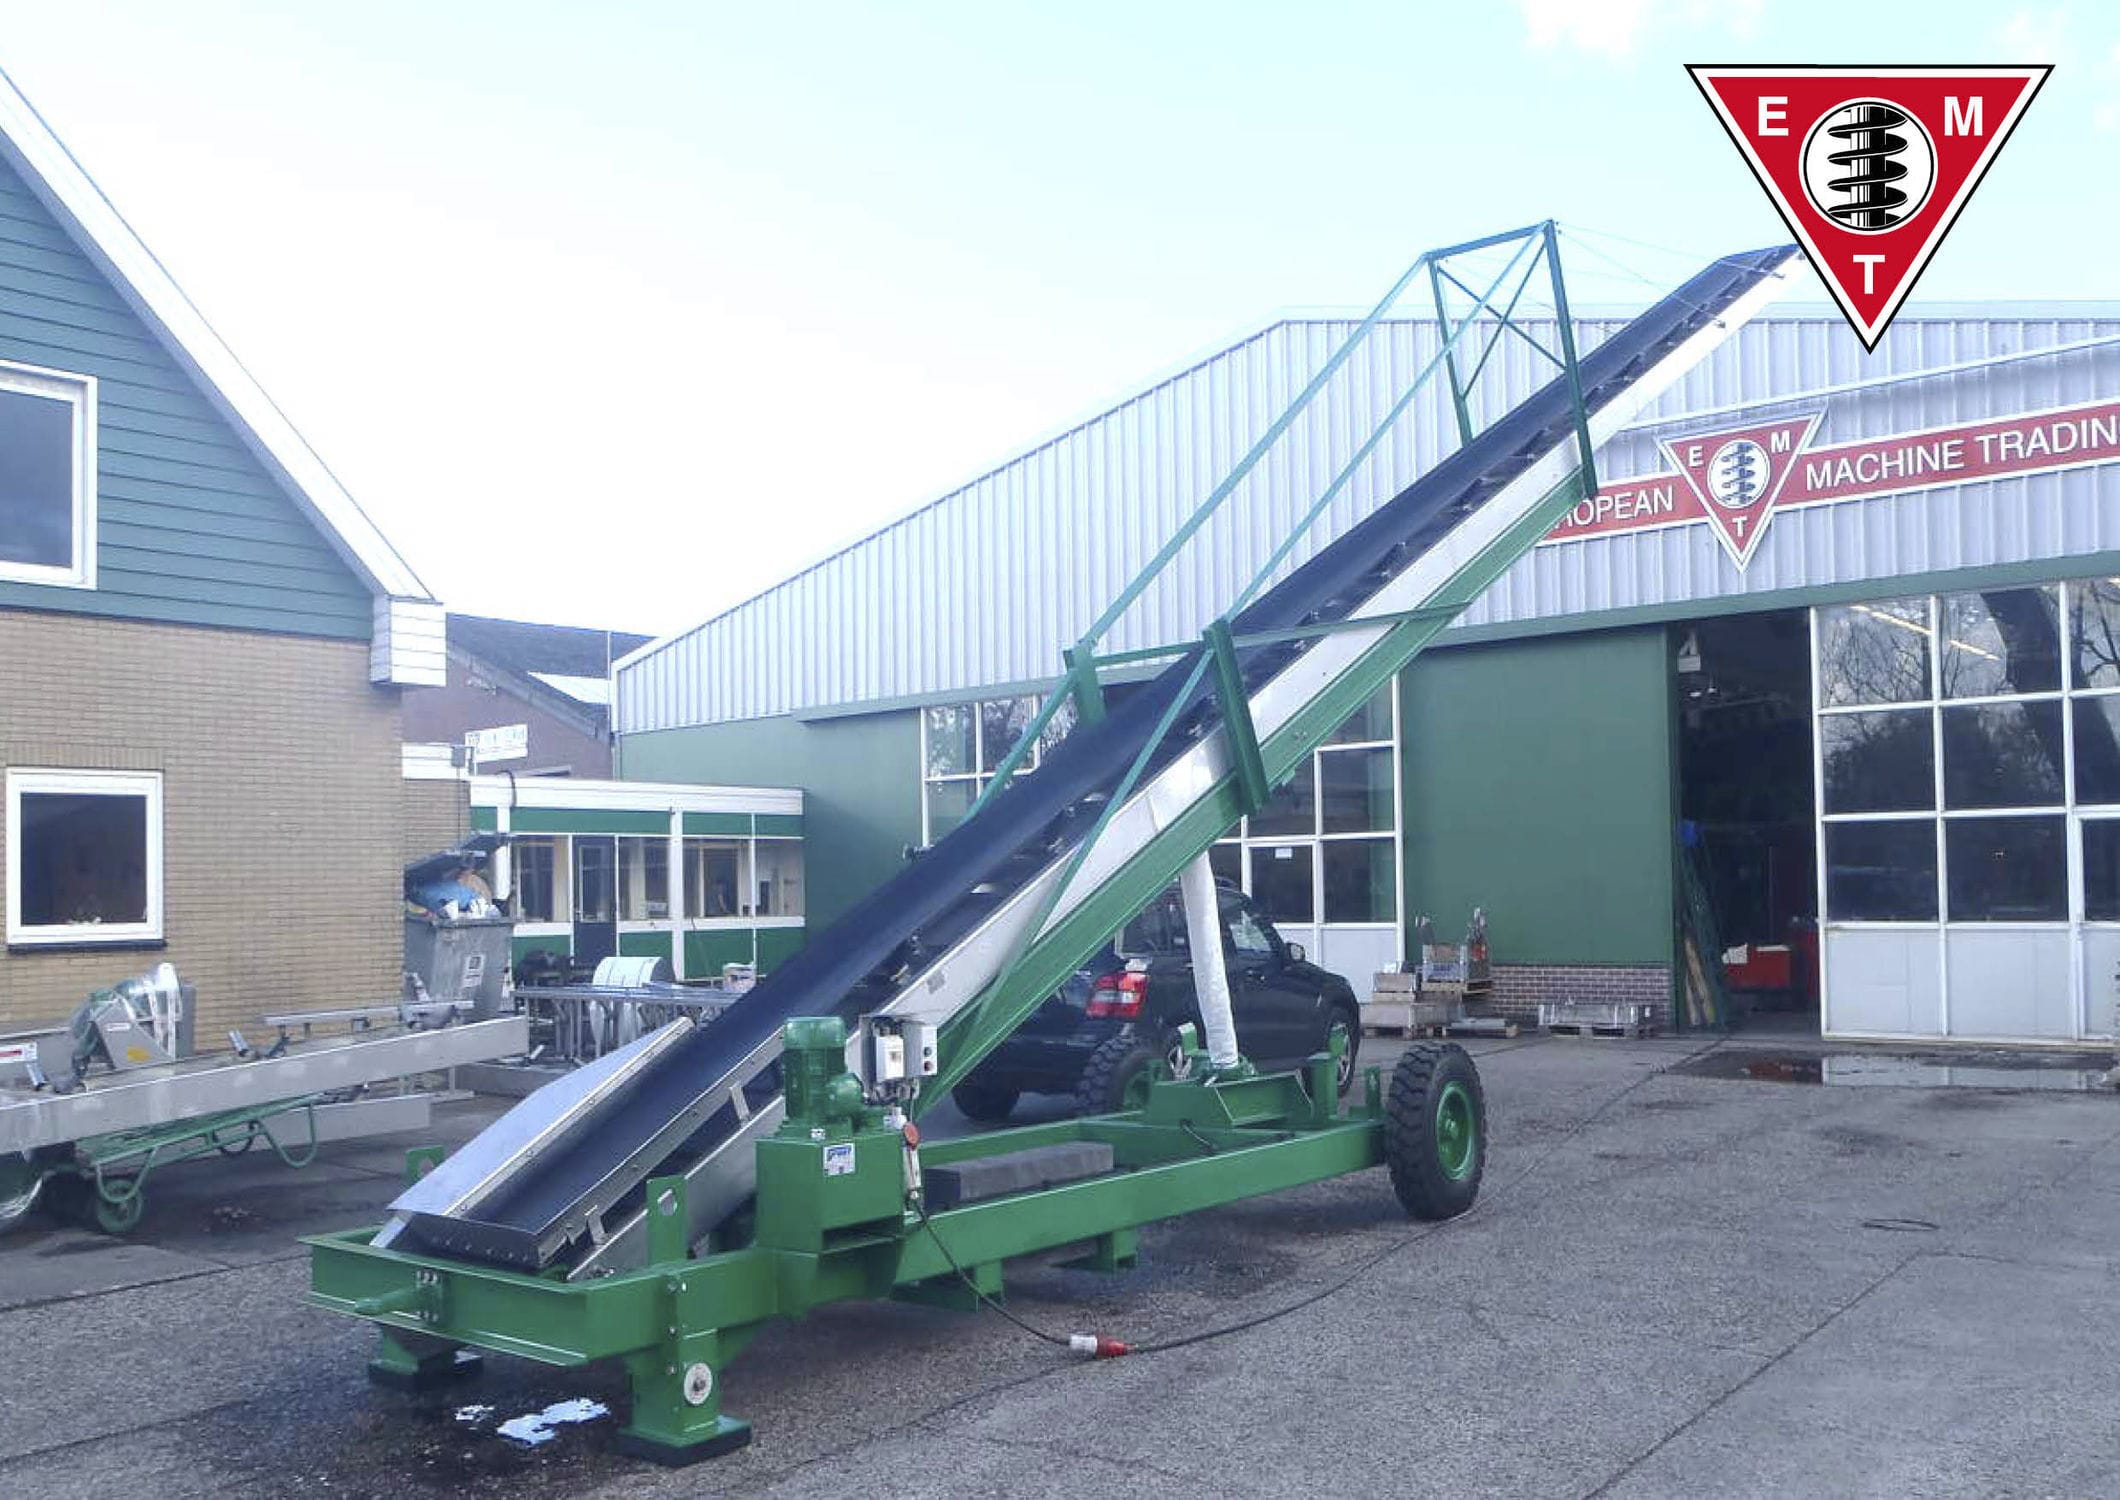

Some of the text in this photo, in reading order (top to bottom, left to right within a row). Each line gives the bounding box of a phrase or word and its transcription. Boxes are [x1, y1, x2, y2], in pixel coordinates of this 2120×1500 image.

[1688, 430, 1791, 467] E M
[1805, 440, 1965, 491] MACHINE
[1732, 516, 1747, 537] T
